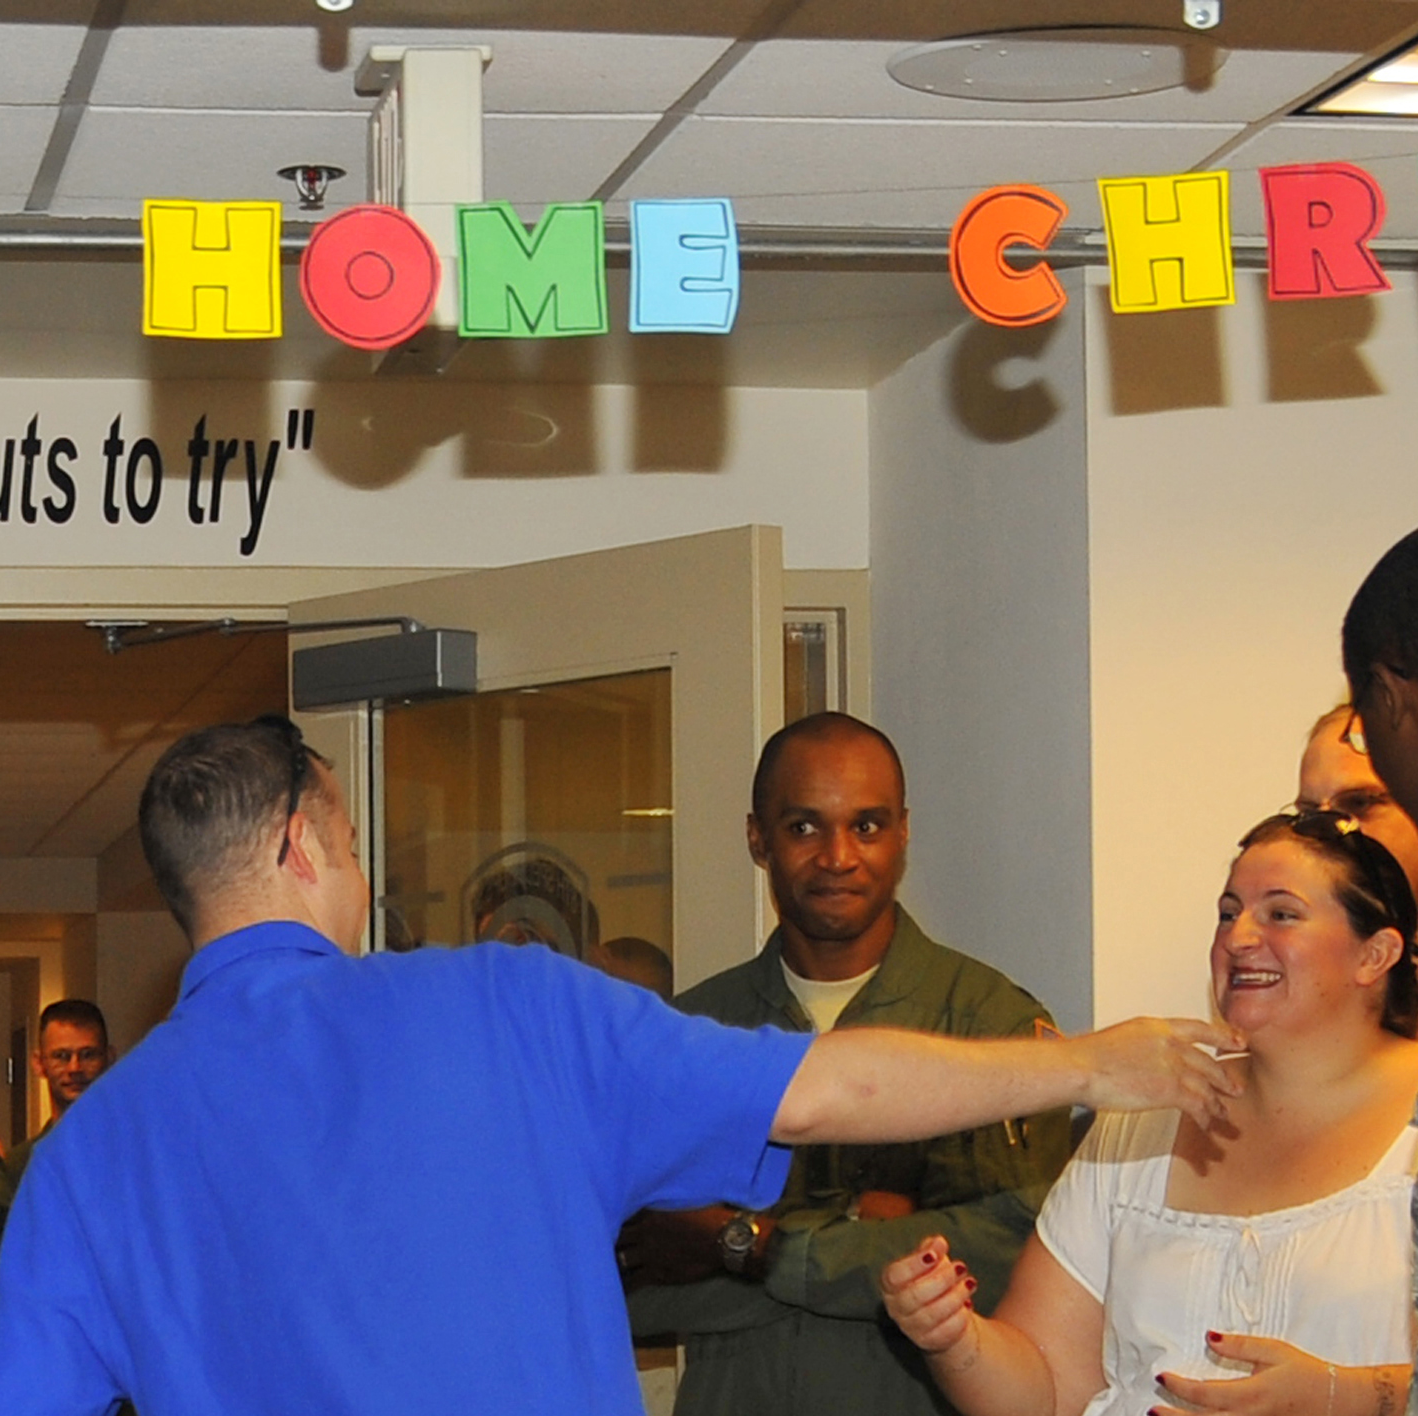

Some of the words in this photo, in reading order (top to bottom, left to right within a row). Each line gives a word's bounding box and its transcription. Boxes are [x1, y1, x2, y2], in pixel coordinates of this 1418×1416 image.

[142, 198, 741, 351] HOME
[103, 412, 163, 524] to
[188, 408, 315, 556] try"
